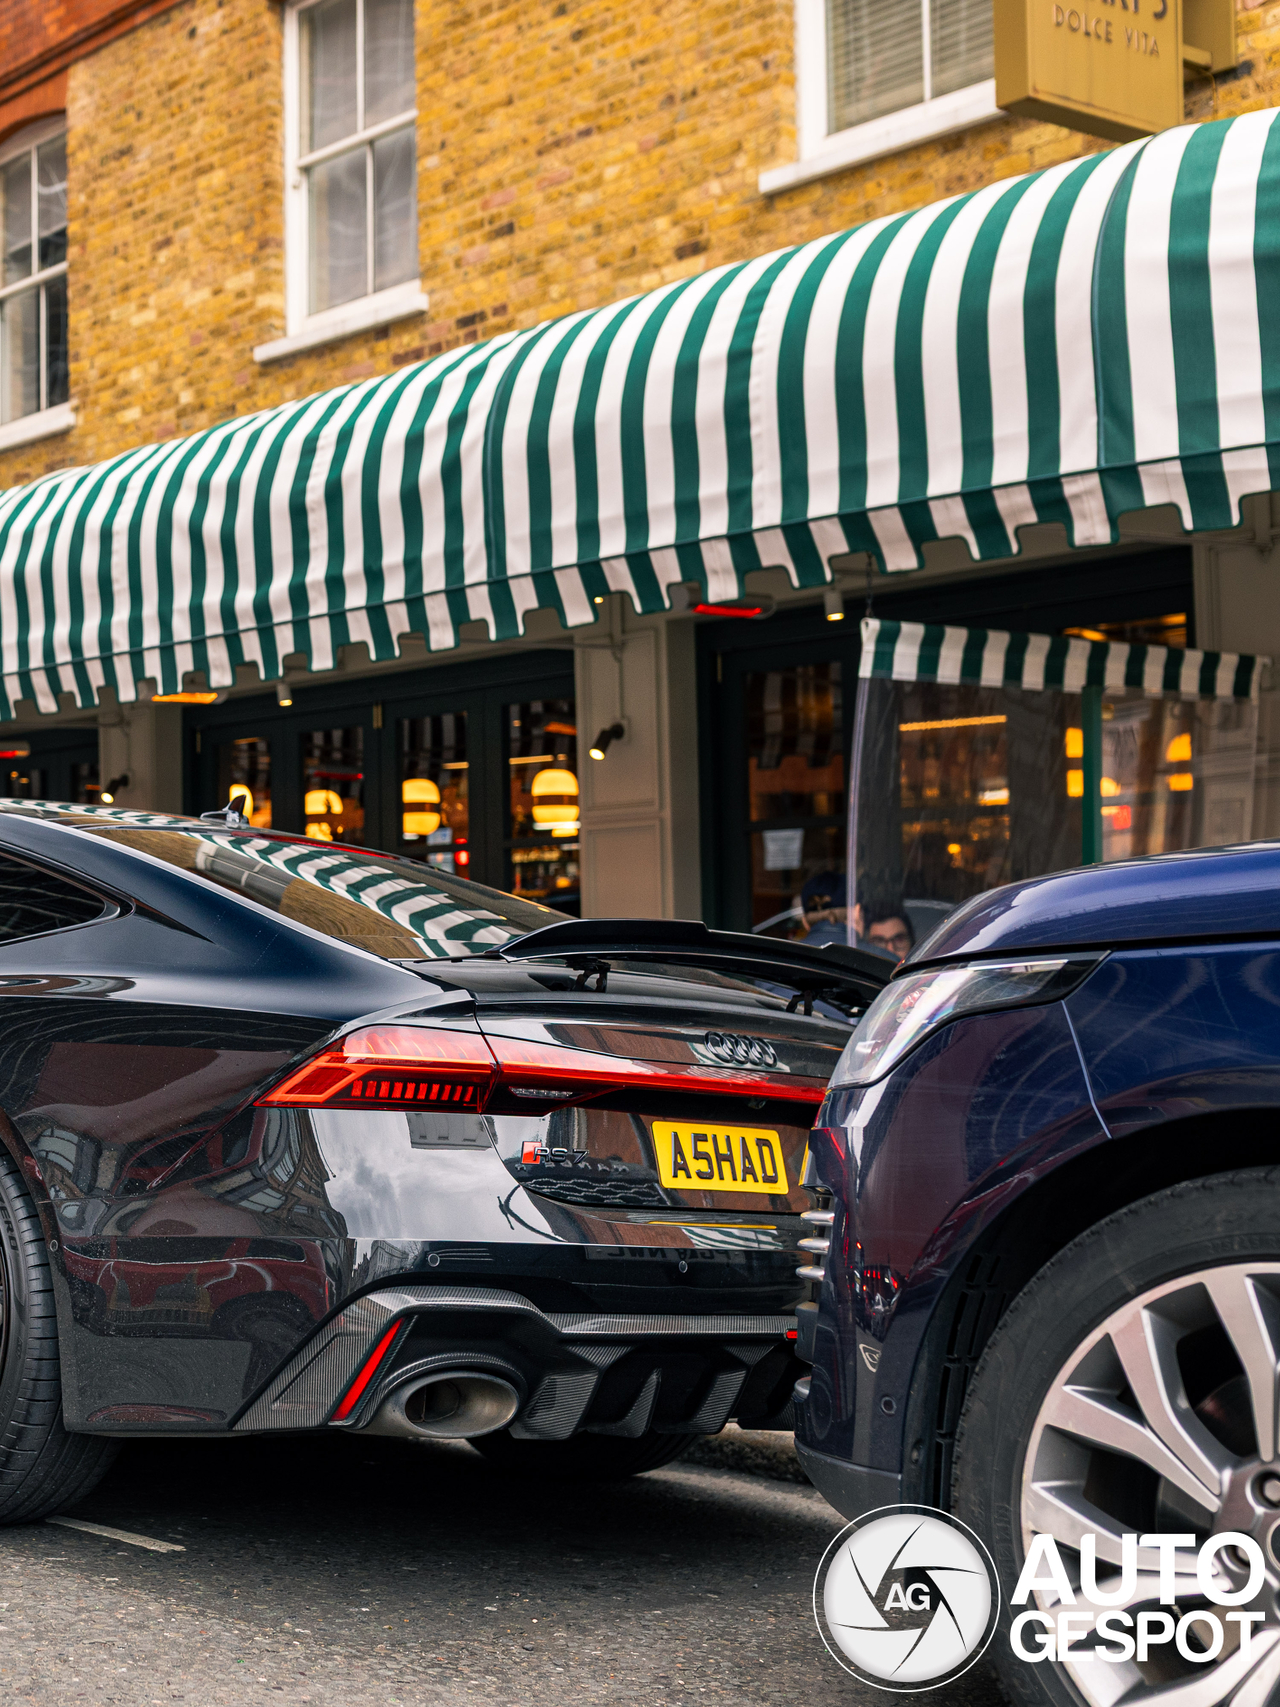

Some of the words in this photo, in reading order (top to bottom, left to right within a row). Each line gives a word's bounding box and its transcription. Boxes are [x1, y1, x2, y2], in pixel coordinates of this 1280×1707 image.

[1053, 4, 1113, 44] DOLCE
[1124, 25, 1160, 57] VITA
[671, 1131, 779, 1184] A5HAD
